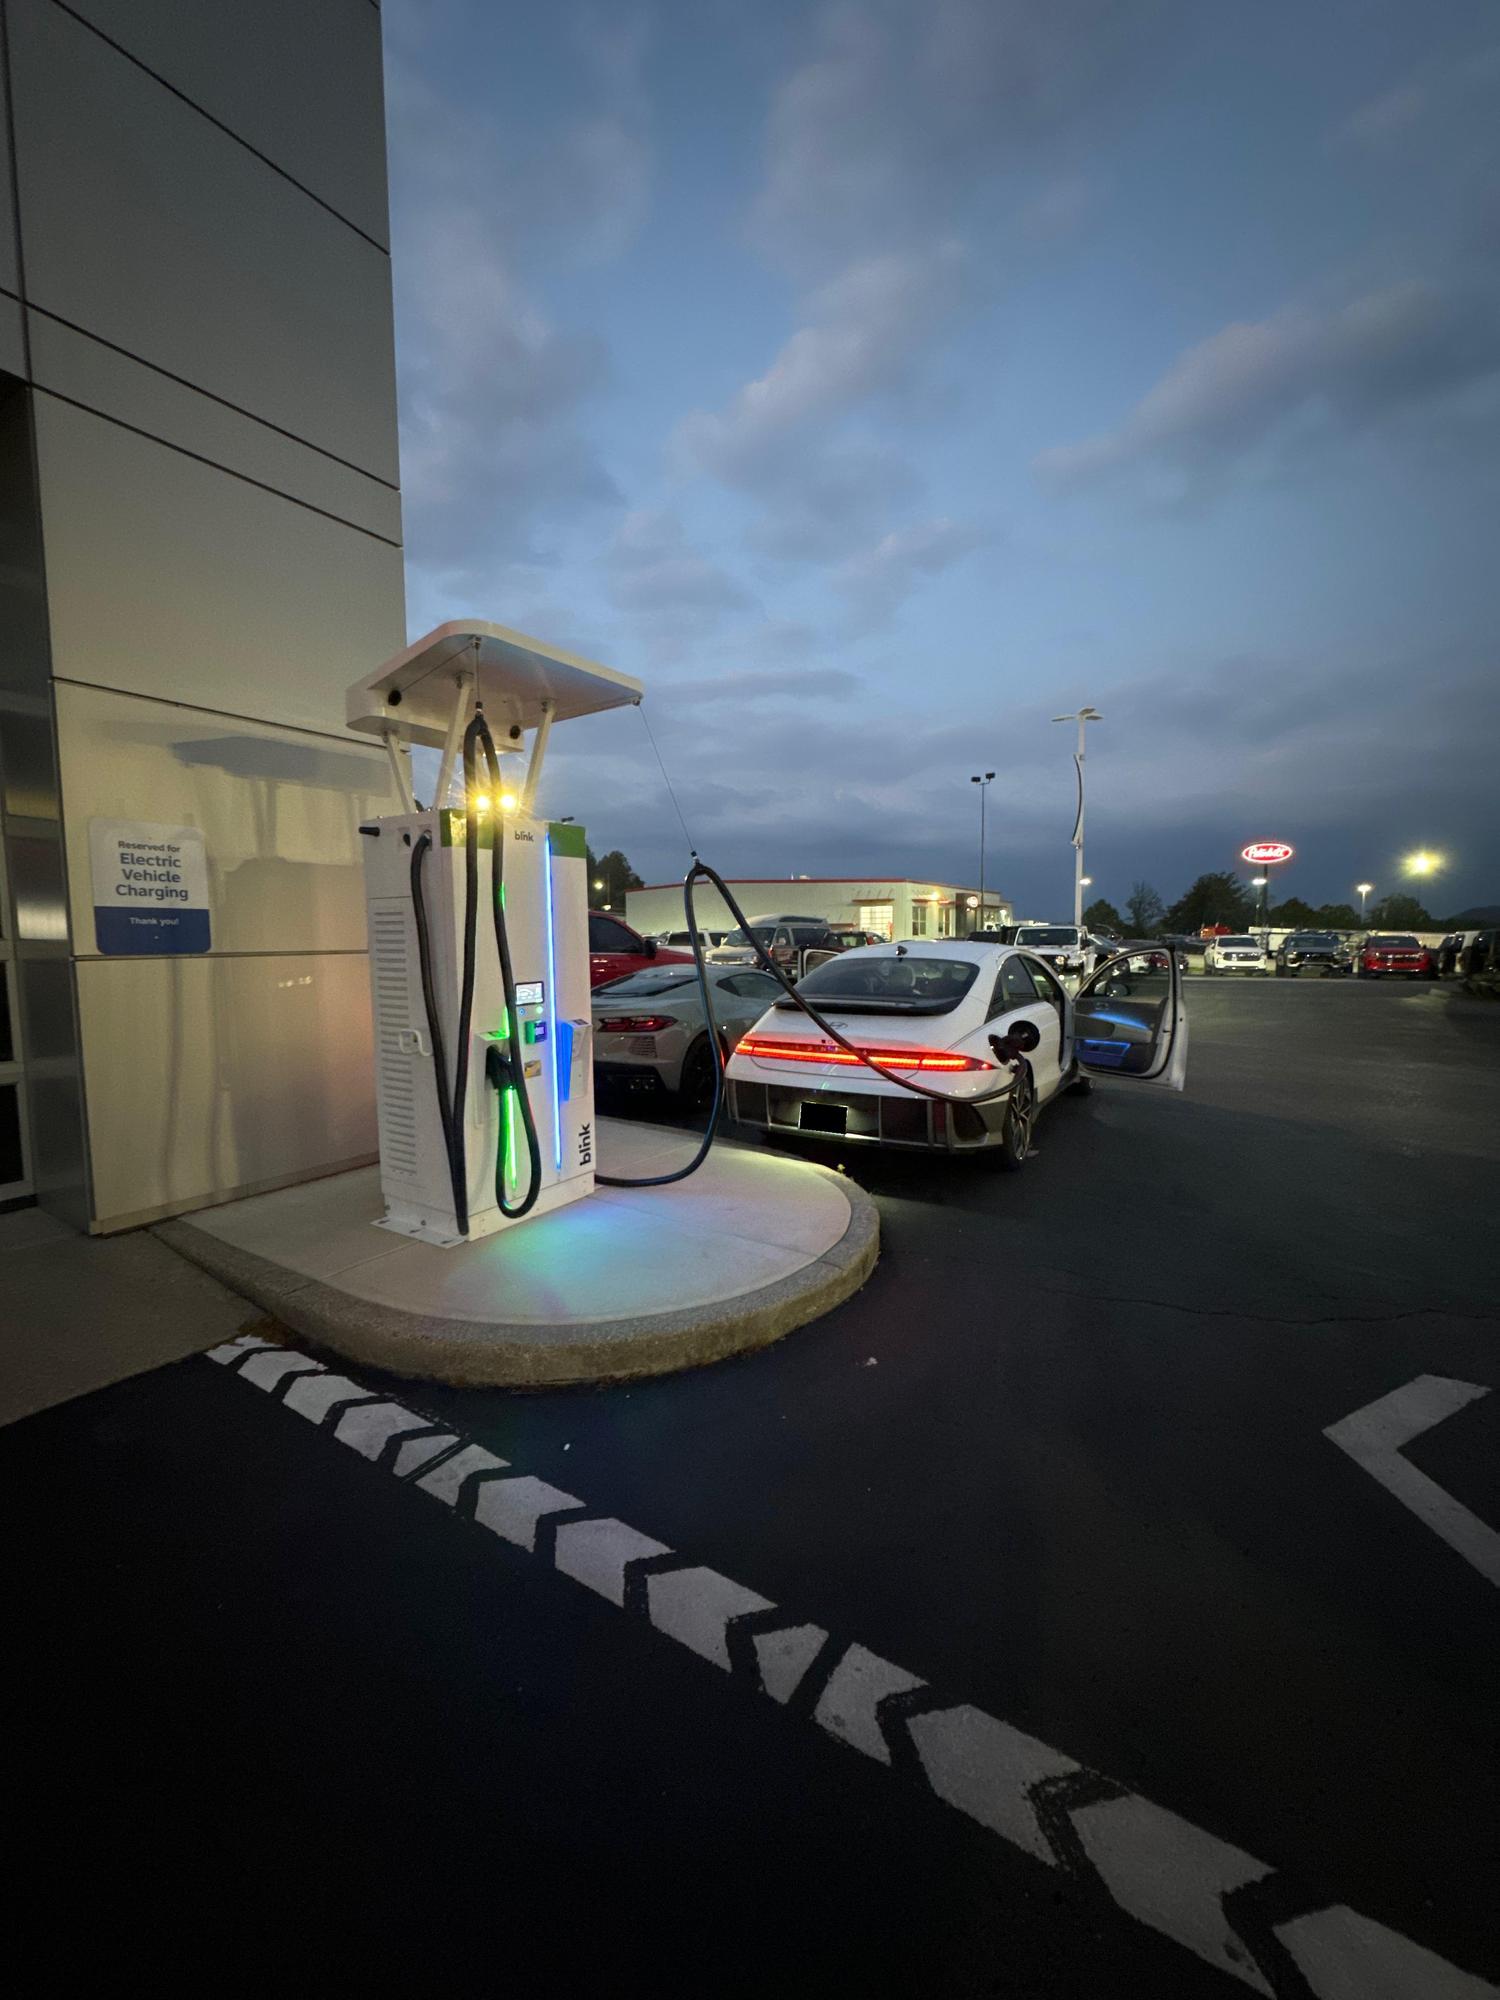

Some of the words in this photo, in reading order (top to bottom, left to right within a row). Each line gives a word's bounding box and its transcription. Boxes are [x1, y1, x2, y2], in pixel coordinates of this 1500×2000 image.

[514, 830, 534, 842] blink
[118, 841, 164, 852] Reserved
[120, 853, 182, 868] Electric
[122, 869, 181, 883] Vehicle
[116, 884, 189, 901] Charging
[130, 917, 157, 925] Thank
[159, 918, 179, 927] you!
[578, 1123, 591, 1166] blink
